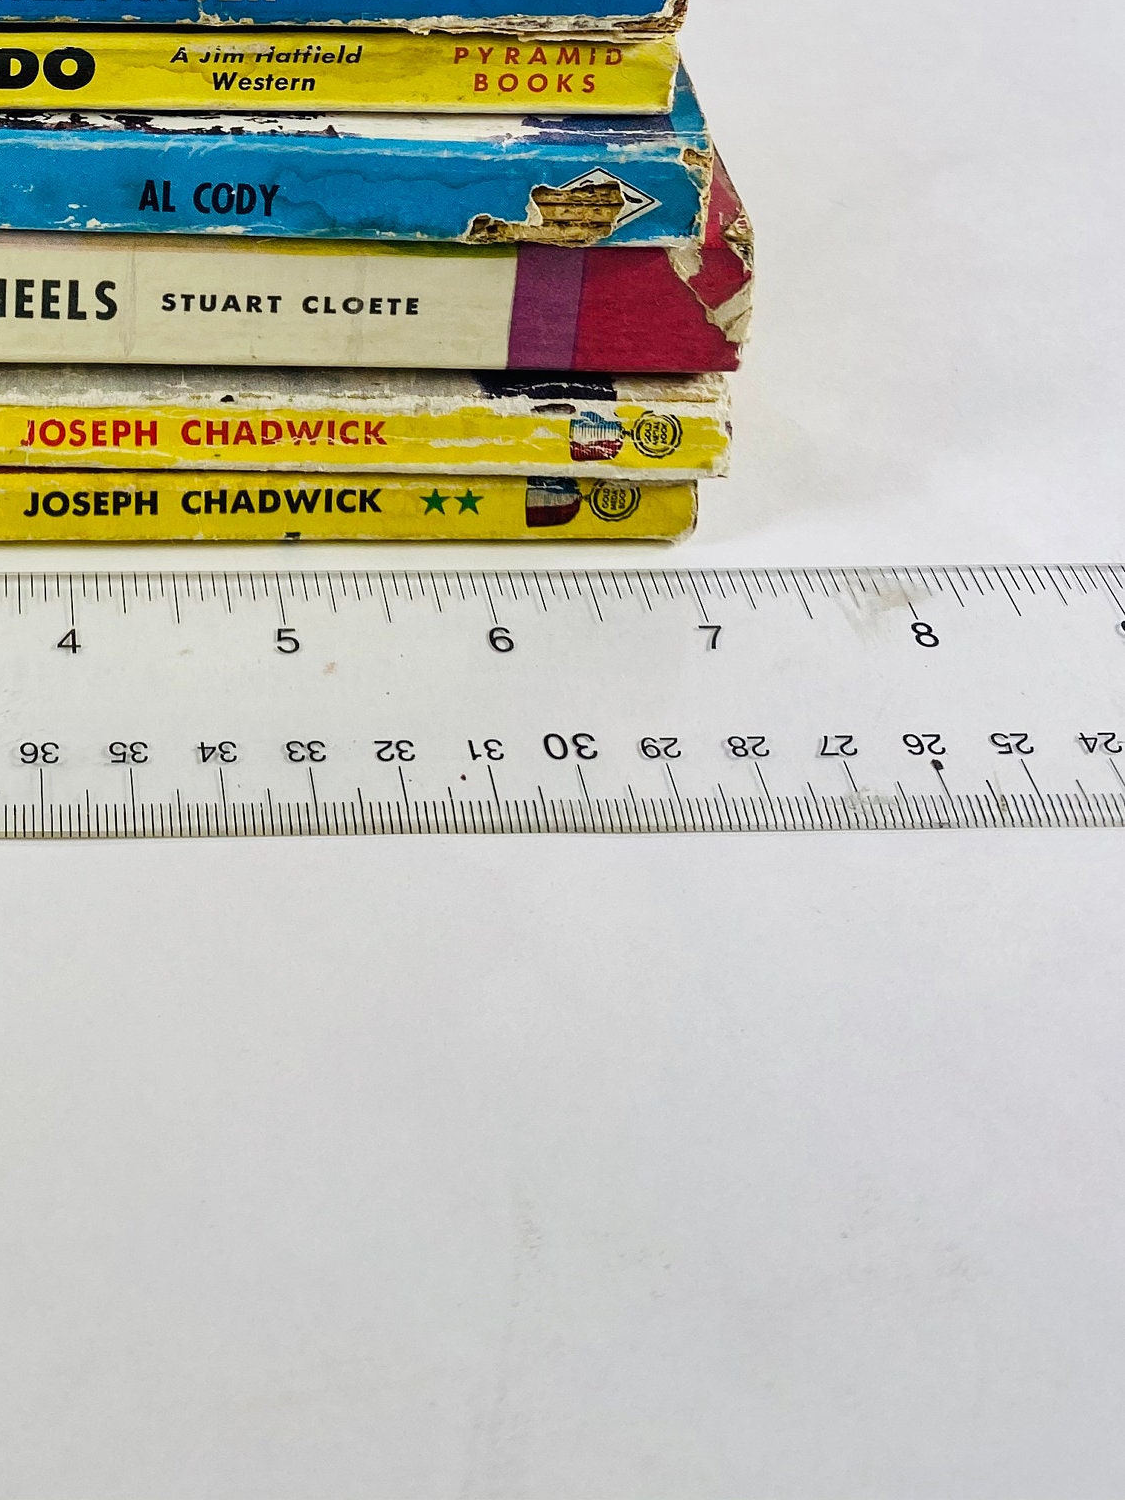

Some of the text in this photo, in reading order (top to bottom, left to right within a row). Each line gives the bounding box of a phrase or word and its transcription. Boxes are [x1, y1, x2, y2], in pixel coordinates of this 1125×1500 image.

[169, 45, 364, 67] A Jim Hatfield
[452, 46, 624, 67] PYRAMID
[211, 71, 317, 93] Western
[473, 73, 598, 94] BOOKS
[138, 178, 281, 219] AL CODY
[160, 292, 421, 317] STUART CLOETE
[19, 418, 389, 449] JOSEPH CHADWICK
[23, 488, 383, 518] JOSEPH CHADWICK
[56, 628, 82, 654] 4
[276, 628, 300, 654] 5
[488, 626, 515, 653] 6
[697, 625, 723, 650] 7
[910, 622, 940, 648] 8
[18, 741, 60, 764] 36
[107, 741, 150, 764] 35
[197, 741, 238, 763] 34
[285, 740, 328, 763] 33
[373, 739, 417, 762] 32
[466, 738, 506, 761] 31
[542, 732, 599, 760] 30
[640, 737, 682, 759] 29
[727, 736, 770, 758] 28
[820, 735, 860, 757] 27
[902, 733, 946, 756] 26
[990, 732, 1034, 755] 25
[1078, 732, 1125, 754] 24
